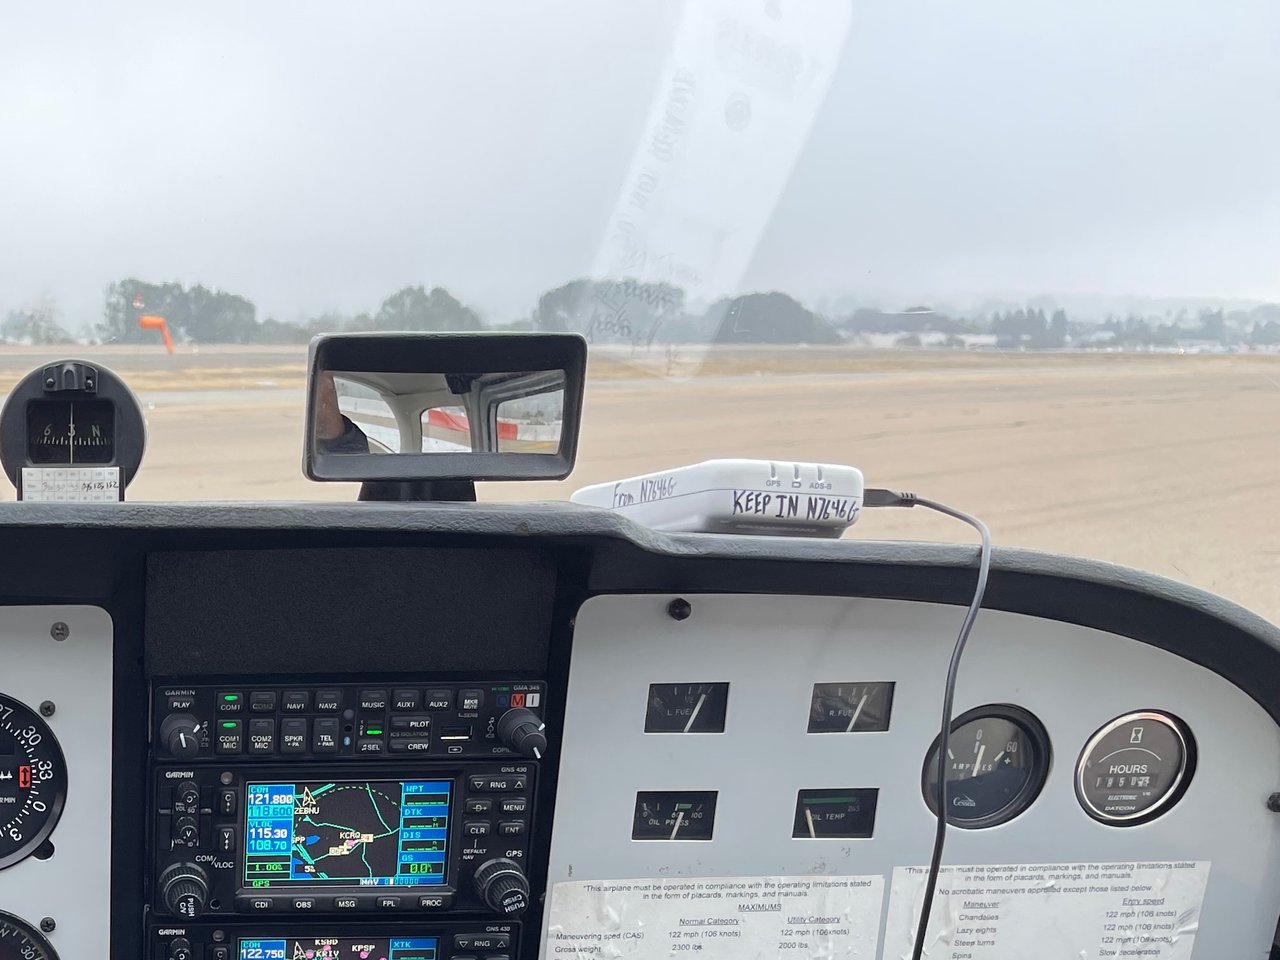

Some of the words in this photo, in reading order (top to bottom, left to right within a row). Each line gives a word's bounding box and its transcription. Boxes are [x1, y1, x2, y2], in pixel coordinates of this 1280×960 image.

[766, 479, 781, 487] GPS
[809, 482, 832, 490] ADS-B
[732, 490, 771, 515] KEEP
[775, 496, 798, 518] IN
[806, 496, 860, 522] N7646G
[23, 726, 42, 746] 30
[1110, 765, 1148, 774] HOURS
[249, 794, 293, 805] 121.800
[250, 829, 287, 839] 115.30
[738, 904, 782, 912] MAXIMUMS
[679, 918, 705, 926] Normal
[683, 931, 699, 939] mph
[241, 949, 284, 959] 122.750
